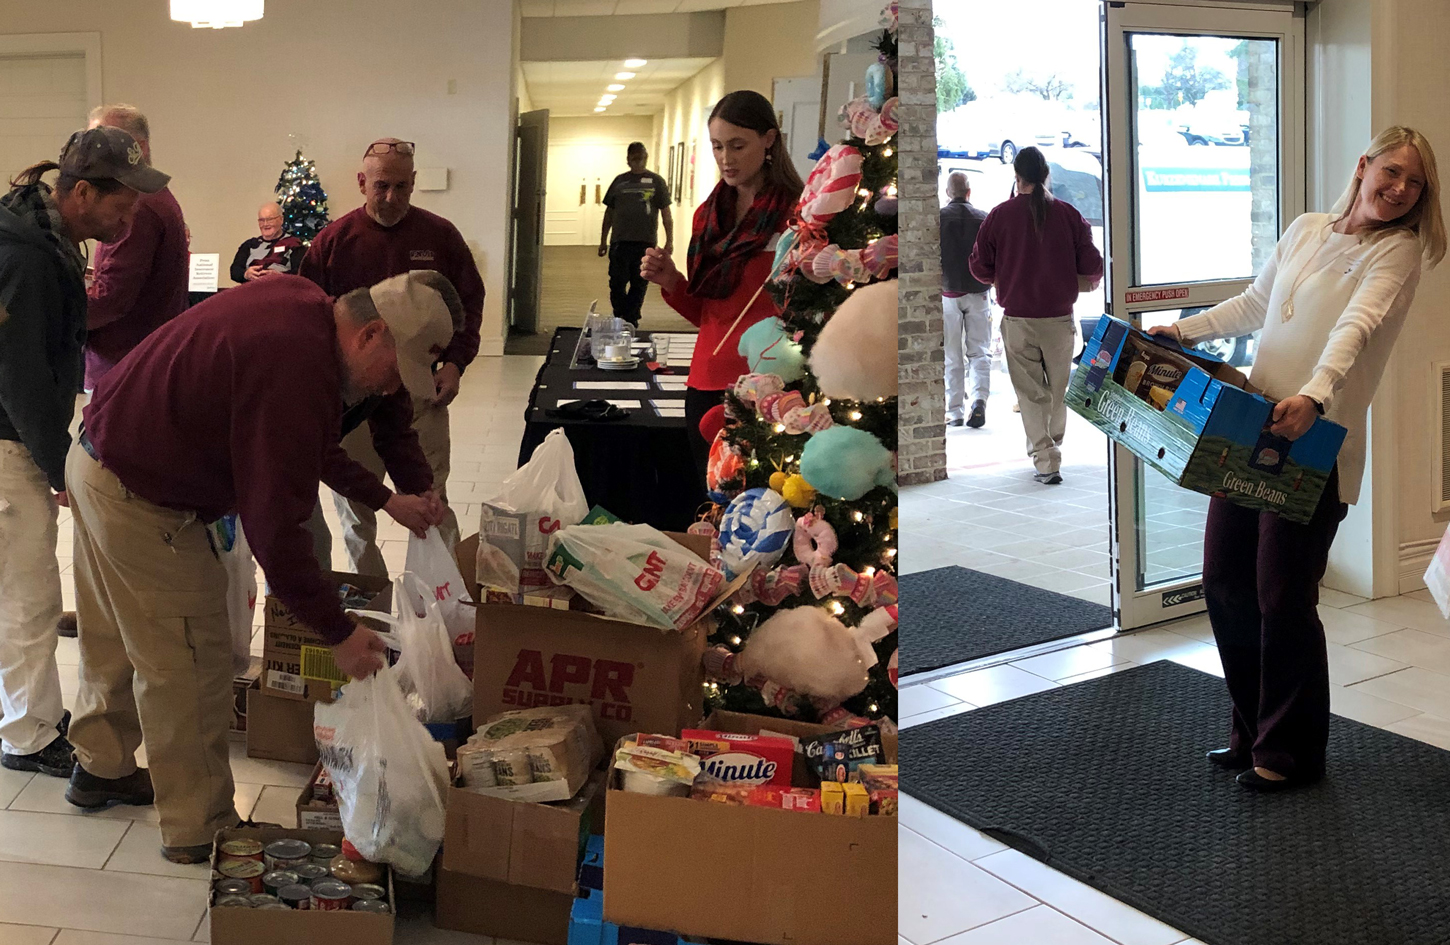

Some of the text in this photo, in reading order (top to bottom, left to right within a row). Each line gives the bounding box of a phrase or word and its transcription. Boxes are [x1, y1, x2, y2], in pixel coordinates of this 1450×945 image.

[1126, 288, 1189, 302] IN EMERGENCY PUSH OPEN
[1151, 365, 1180, 379] Minute
[1098, 390, 1124, 427] Green
[1222, 470, 1288, 506] Green Beans
[504, 648, 635, 704] APR
[699, 756, 777, 781] Minute
